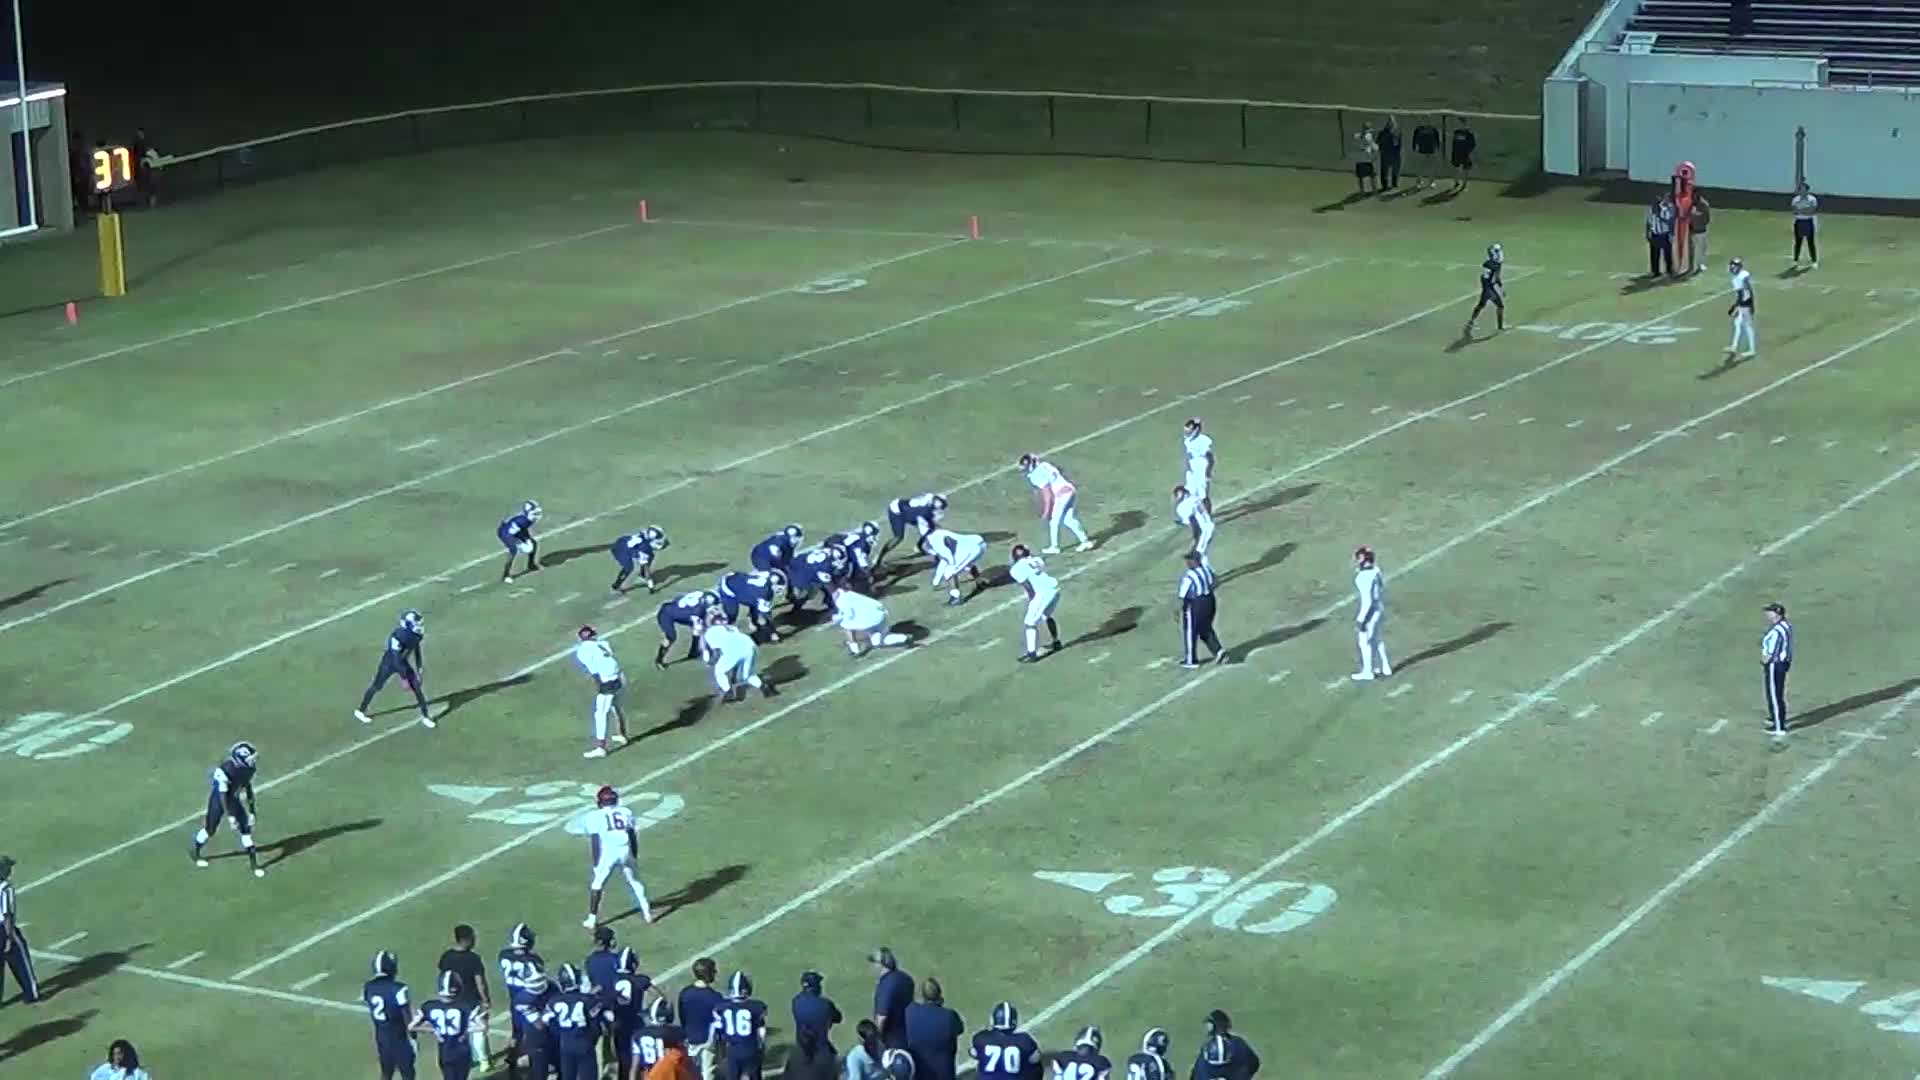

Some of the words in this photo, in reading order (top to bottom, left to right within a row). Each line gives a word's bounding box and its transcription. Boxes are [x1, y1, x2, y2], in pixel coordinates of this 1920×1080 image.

[94, 148, 130, 189] 37
[605, 811, 625, 831] 16
[1103, 866, 1338, 934] 30
[371, 995, 387, 1020] 2
[553, 1001, 587, 1028] 24
[430, 1008, 461, 1036] 33
[723, 1008, 752, 1037] 16
[984, 1044, 1020, 1074] 70
